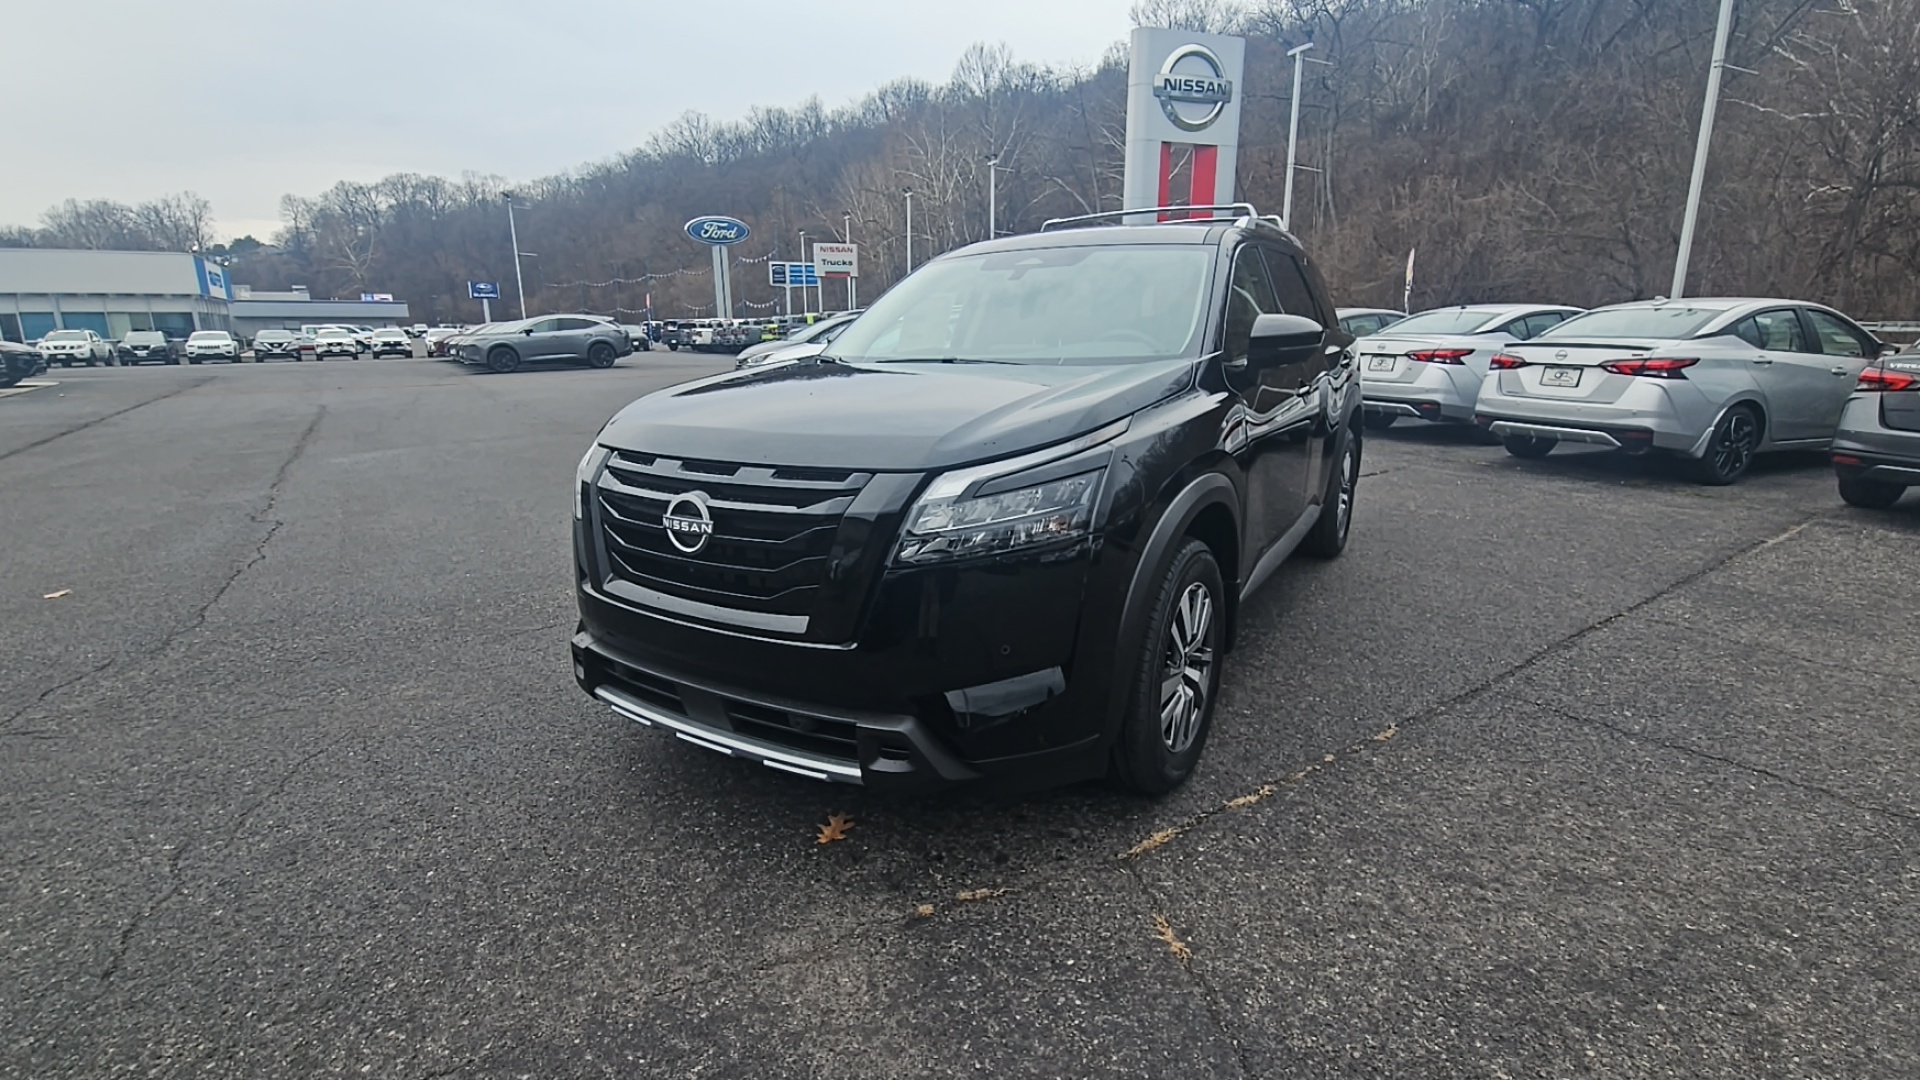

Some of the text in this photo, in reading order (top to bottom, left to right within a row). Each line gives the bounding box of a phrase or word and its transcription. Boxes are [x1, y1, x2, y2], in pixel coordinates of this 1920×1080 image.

[1164, 78, 1227, 96] NISSAN
[701, 221, 738, 239] Ford
[662, 517, 712, 534] NISSAN
